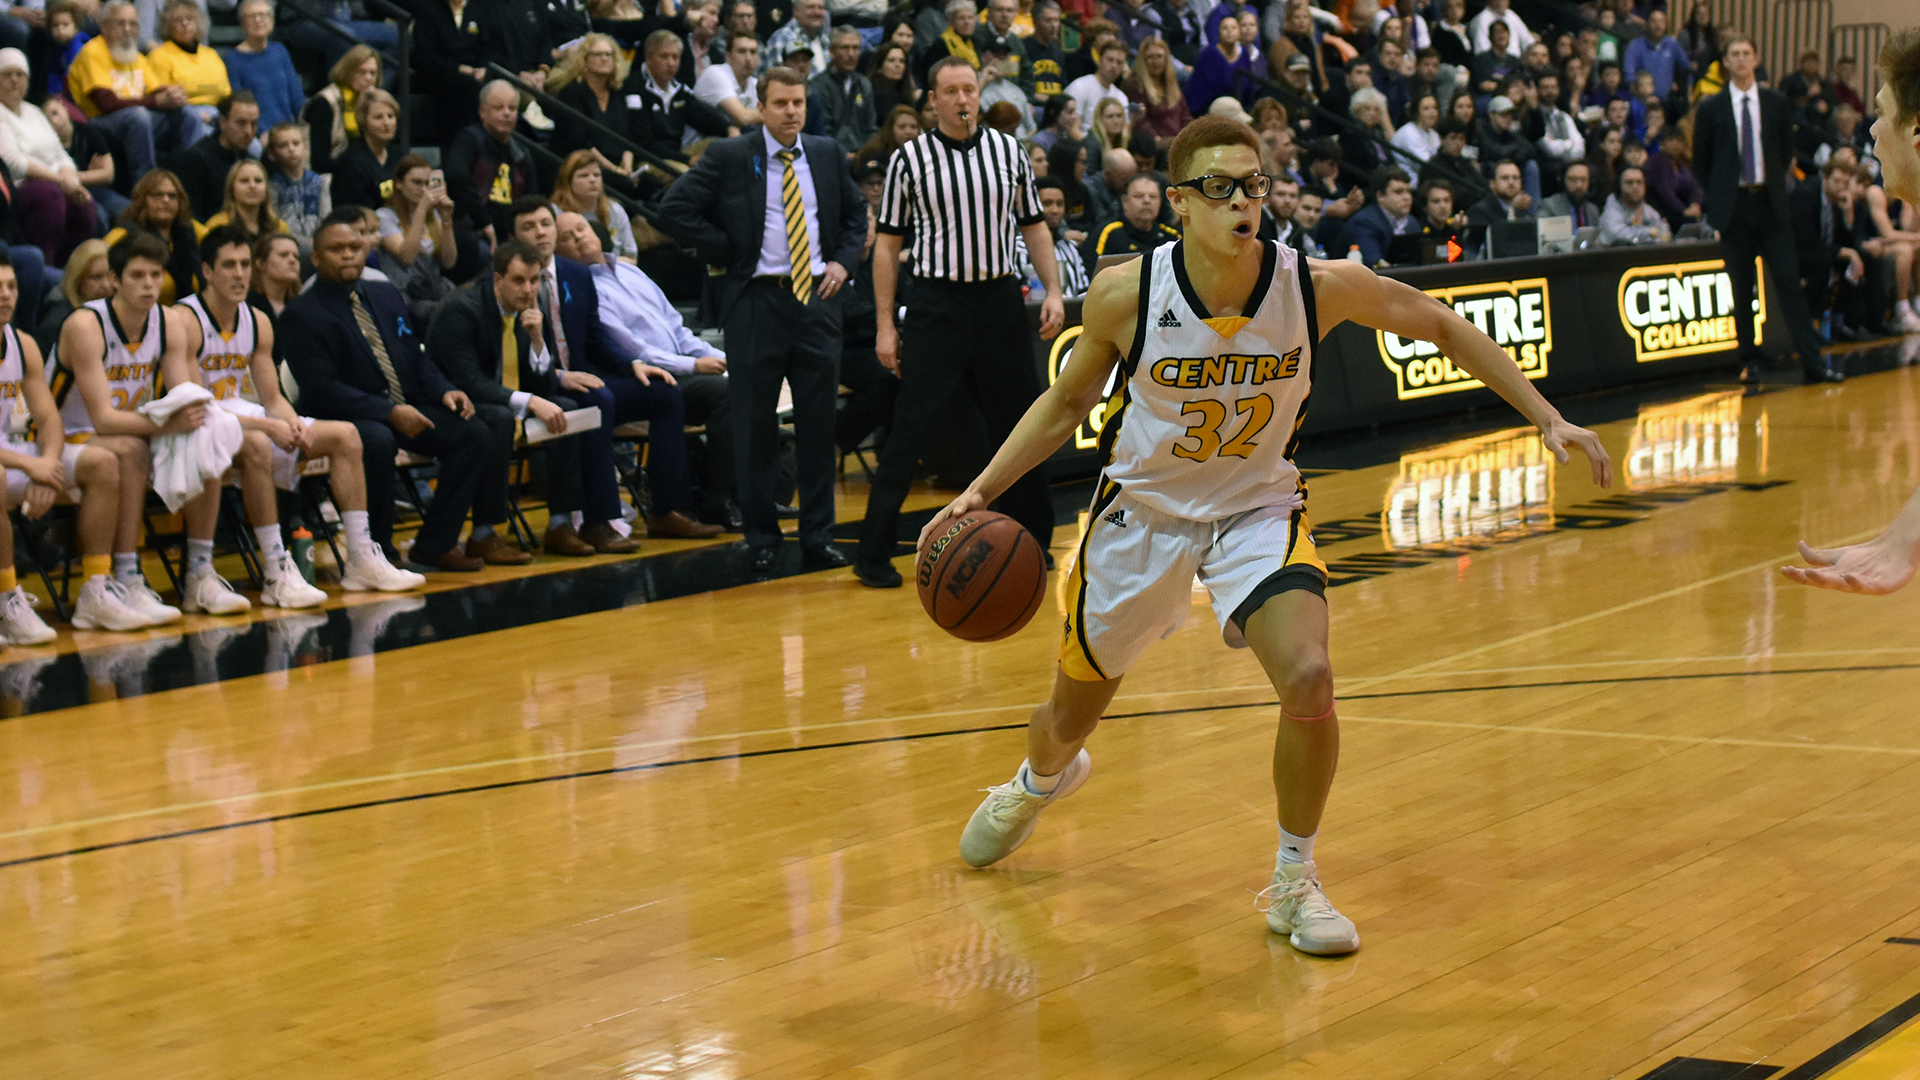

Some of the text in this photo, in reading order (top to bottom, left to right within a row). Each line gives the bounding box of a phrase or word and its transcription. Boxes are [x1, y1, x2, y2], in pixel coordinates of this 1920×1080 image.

[1624, 272, 1736, 326] CENTR
[1157, 319, 1182, 328] adidas
[1643, 316, 1738, 351] COLONEL
[1150, 346, 1302, 388] CENTRE
[1172, 393, 1274, 462] 32
[1103, 515, 1127, 529] adidas
[919, 516, 975, 588] Wilson
[946, 538, 994, 600] NCAA
